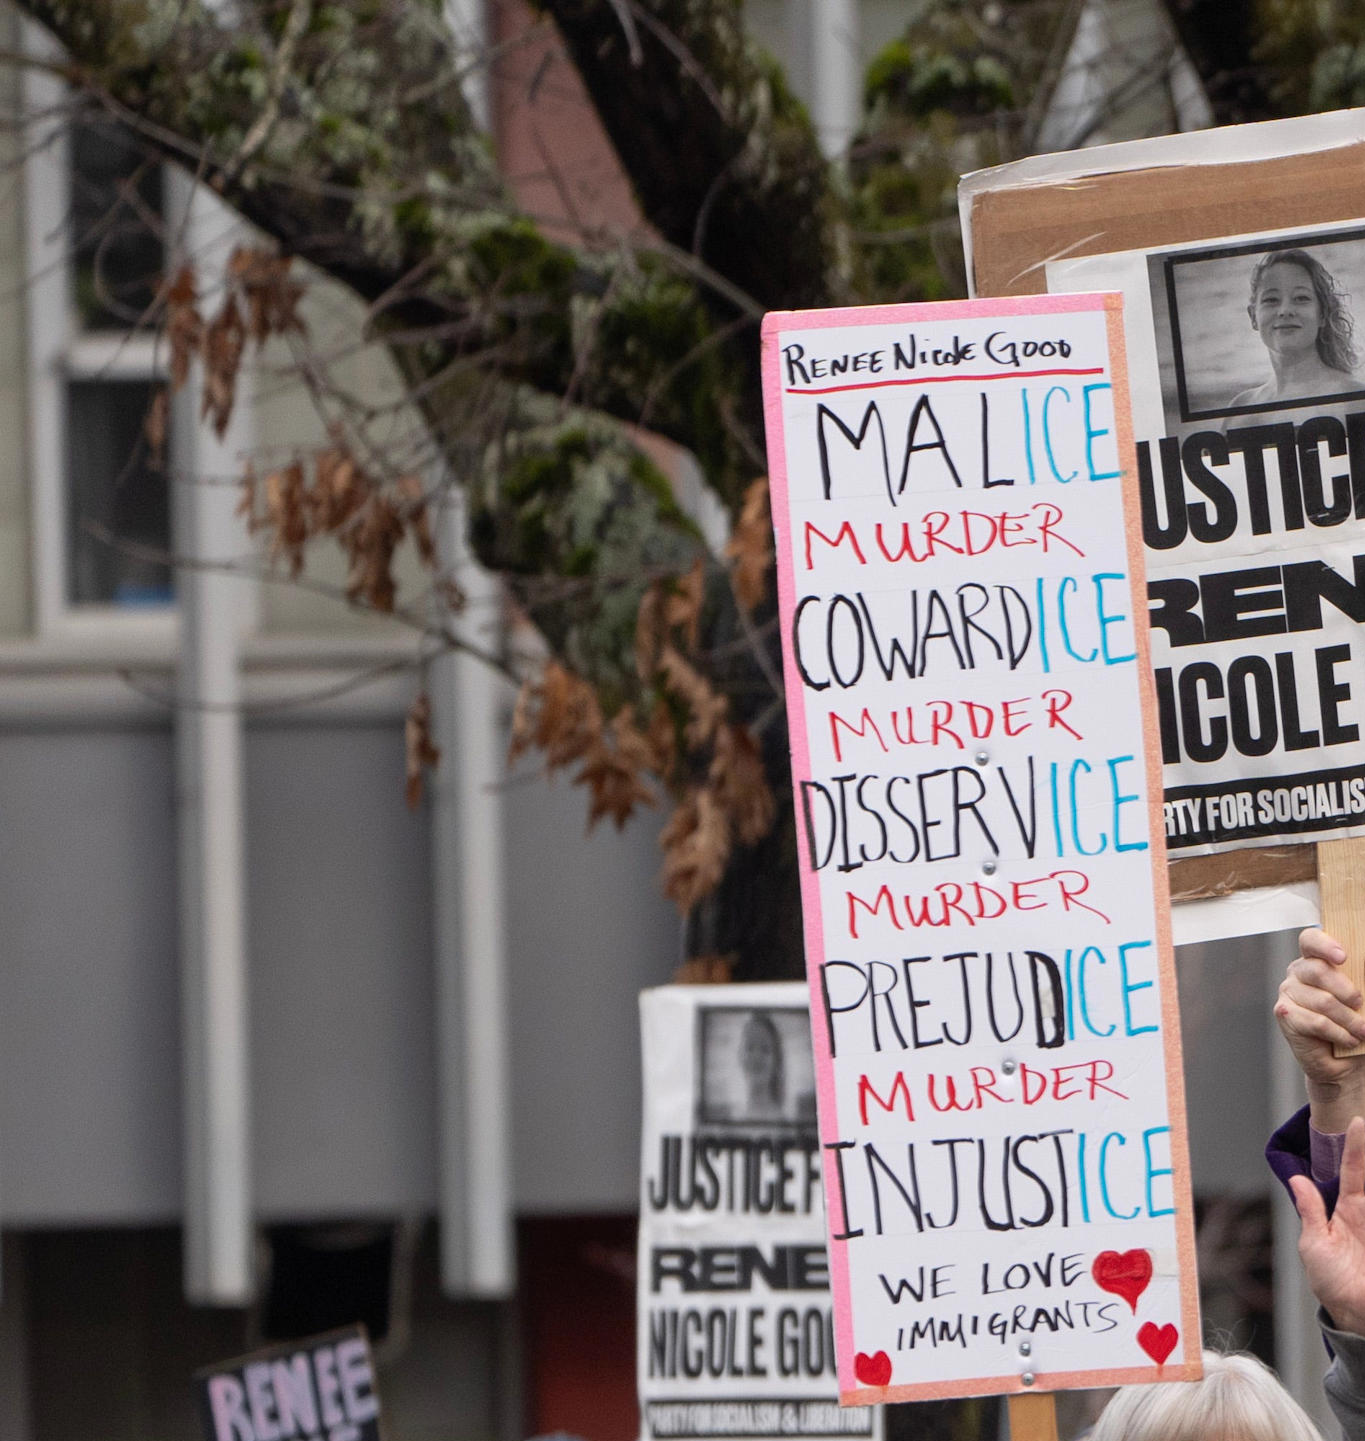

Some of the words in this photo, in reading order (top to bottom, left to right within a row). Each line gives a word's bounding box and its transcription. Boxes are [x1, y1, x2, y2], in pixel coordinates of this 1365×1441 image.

[782, 344, 886, 385] RENEE
[817, 384, 1127, 506] MALICE
[803, 503, 1086, 569] MURDER
[793, 574, 1138, 691] COWARDICE
[829, 690, 1083, 761] MURDER
[1155, 644, 1359, 765] ICOLE
[800, 755, 1148, 872] DISSERVICE
[1164, 798, 1201, 836] RTY
[1207, 790, 1255, 831] FOR
[847, 871, 1111, 937] MURDER
[820, 940, 1158, 1058] PREJUDICE
[857, 1060, 1129, 1125] MURDER
[648, 1134, 796, 1215] JUSTICE
[823, 1126, 1177, 1240] INJUSTICE
[650, 1245, 829, 1292] RENE
[878, 1264, 956, 1304] WE
[981, 1252, 1087, 1294] LOVE
[648, 1306, 767, 1378] NICOLE
[897, 1301, 1120, 1351] IMMIGRANTS
